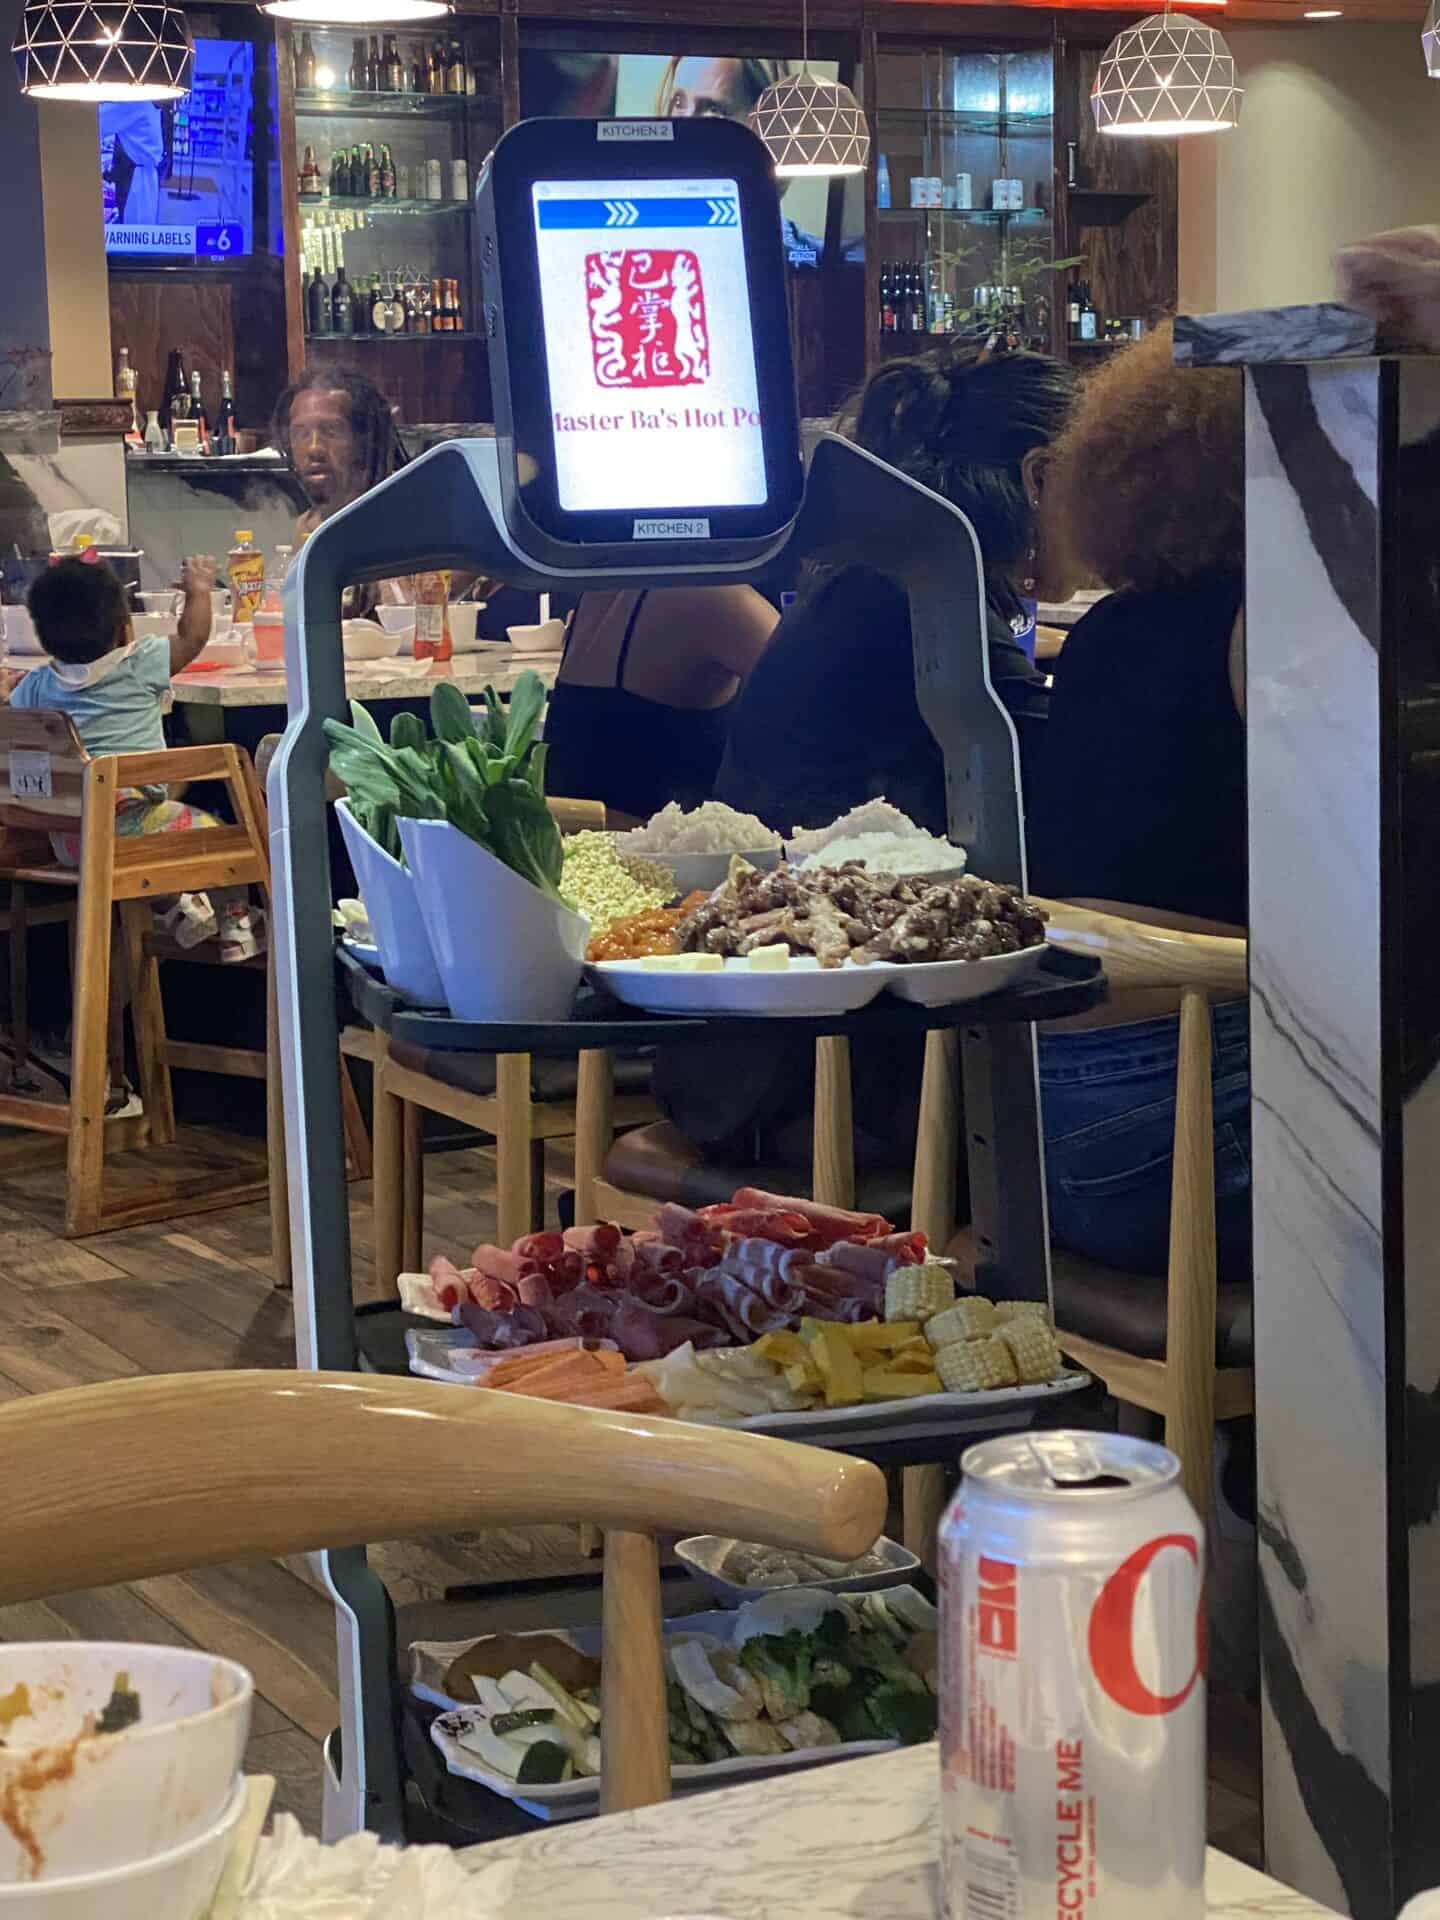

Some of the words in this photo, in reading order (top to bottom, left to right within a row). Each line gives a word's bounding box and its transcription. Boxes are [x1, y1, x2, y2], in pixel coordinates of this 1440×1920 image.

[602, 125, 657, 137] KITCHEN
[661, 125, 668, 136] 2
[152, 232, 191, 246] LABELS
[217, 229, 231, 250] 6
[631, 407, 678, 430] Ba's
[684, 407, 725, 428] Hot
[638, 522, 693, 535] KITCHEN
[696, 522, 704, 534] 2
[1088, 1533, 1207, 1716] C
[1055, 1739, 1083, 1791] ME
